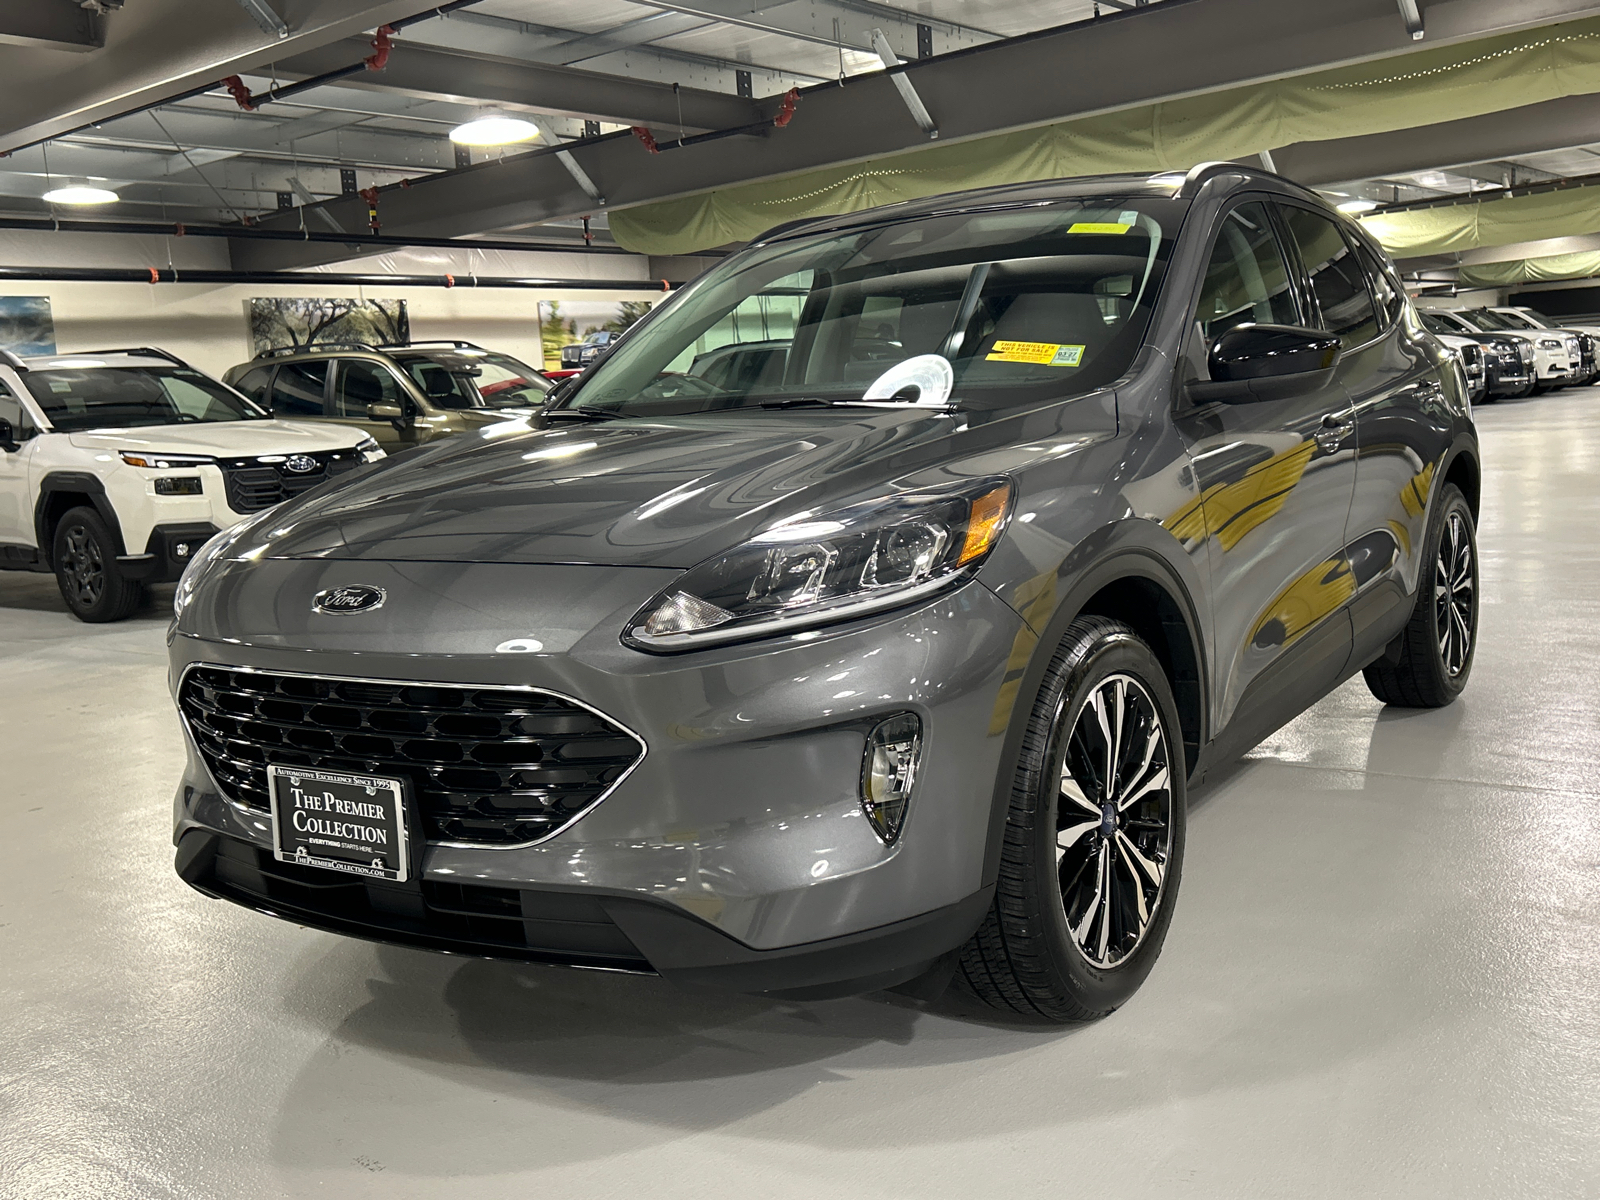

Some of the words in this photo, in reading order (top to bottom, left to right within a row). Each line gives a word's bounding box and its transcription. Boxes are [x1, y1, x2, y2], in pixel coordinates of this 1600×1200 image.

[324, 588, 369, 607] Ford
[290, 787, 323, 811] THE
[308, 837, 341, 848] EVERYTHING
[341, 842, 359, 851] STARTS
